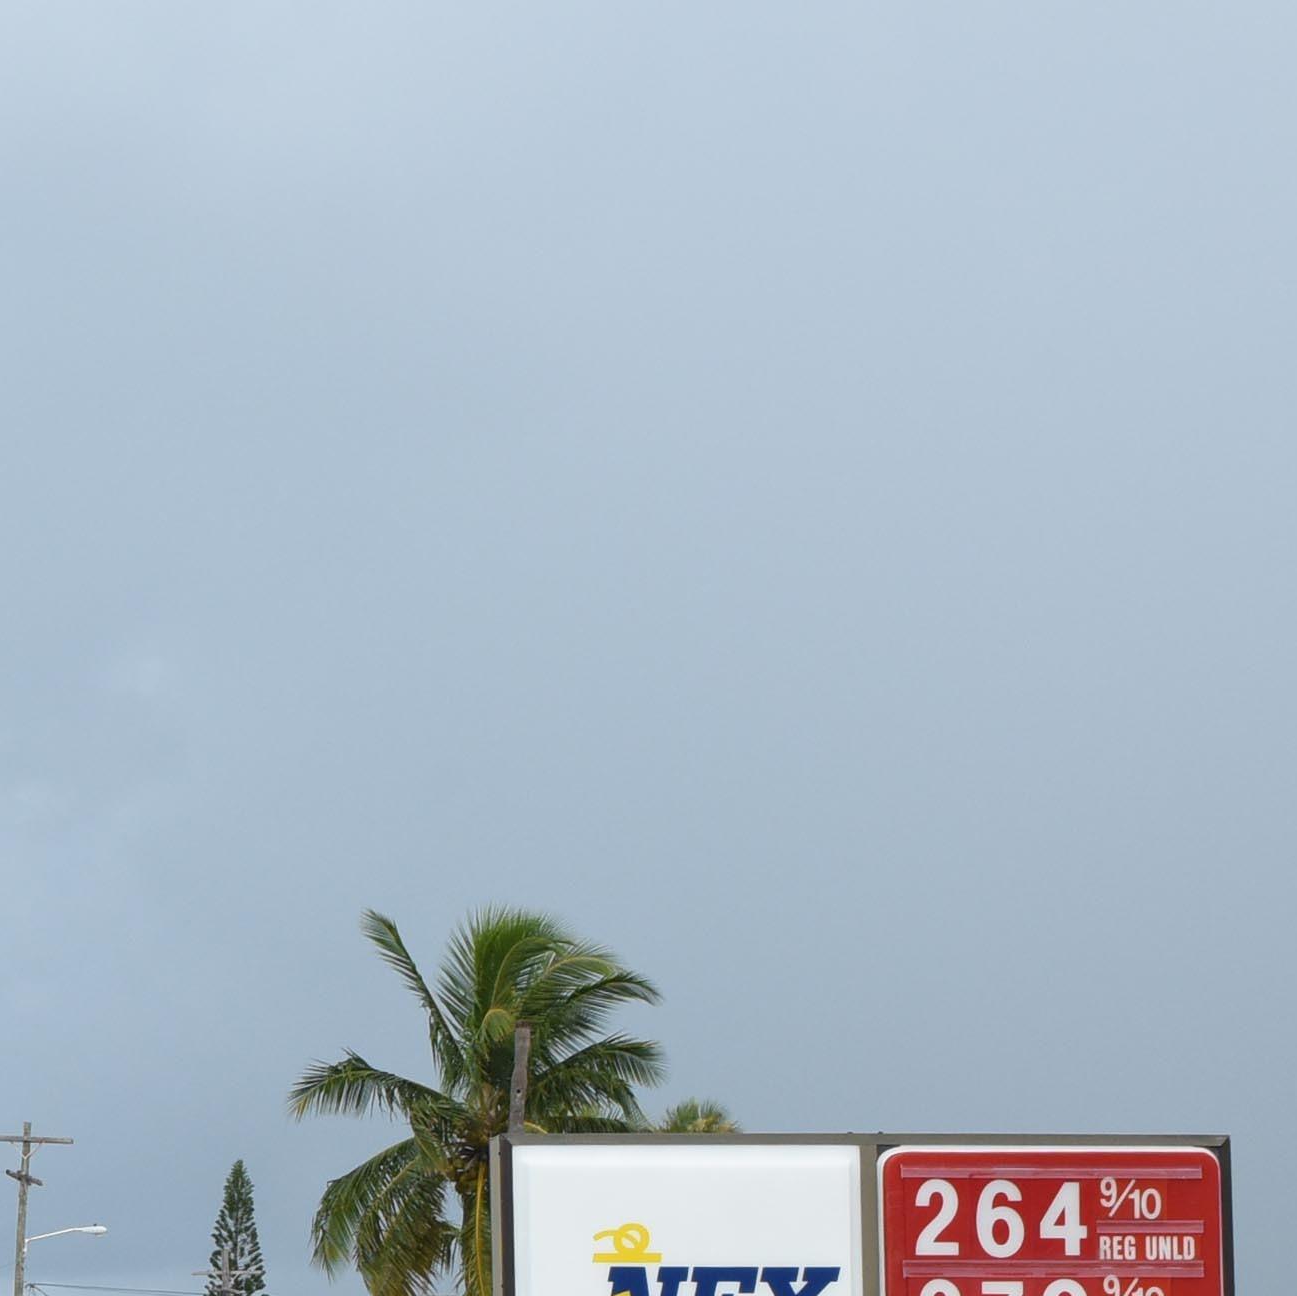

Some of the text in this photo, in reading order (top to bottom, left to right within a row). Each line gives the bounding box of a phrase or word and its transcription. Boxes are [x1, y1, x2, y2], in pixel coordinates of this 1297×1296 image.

[915, 1176, 1162, 1259] 264 9/10
[1099, 1235, 1196, 1261] REG UNLD
